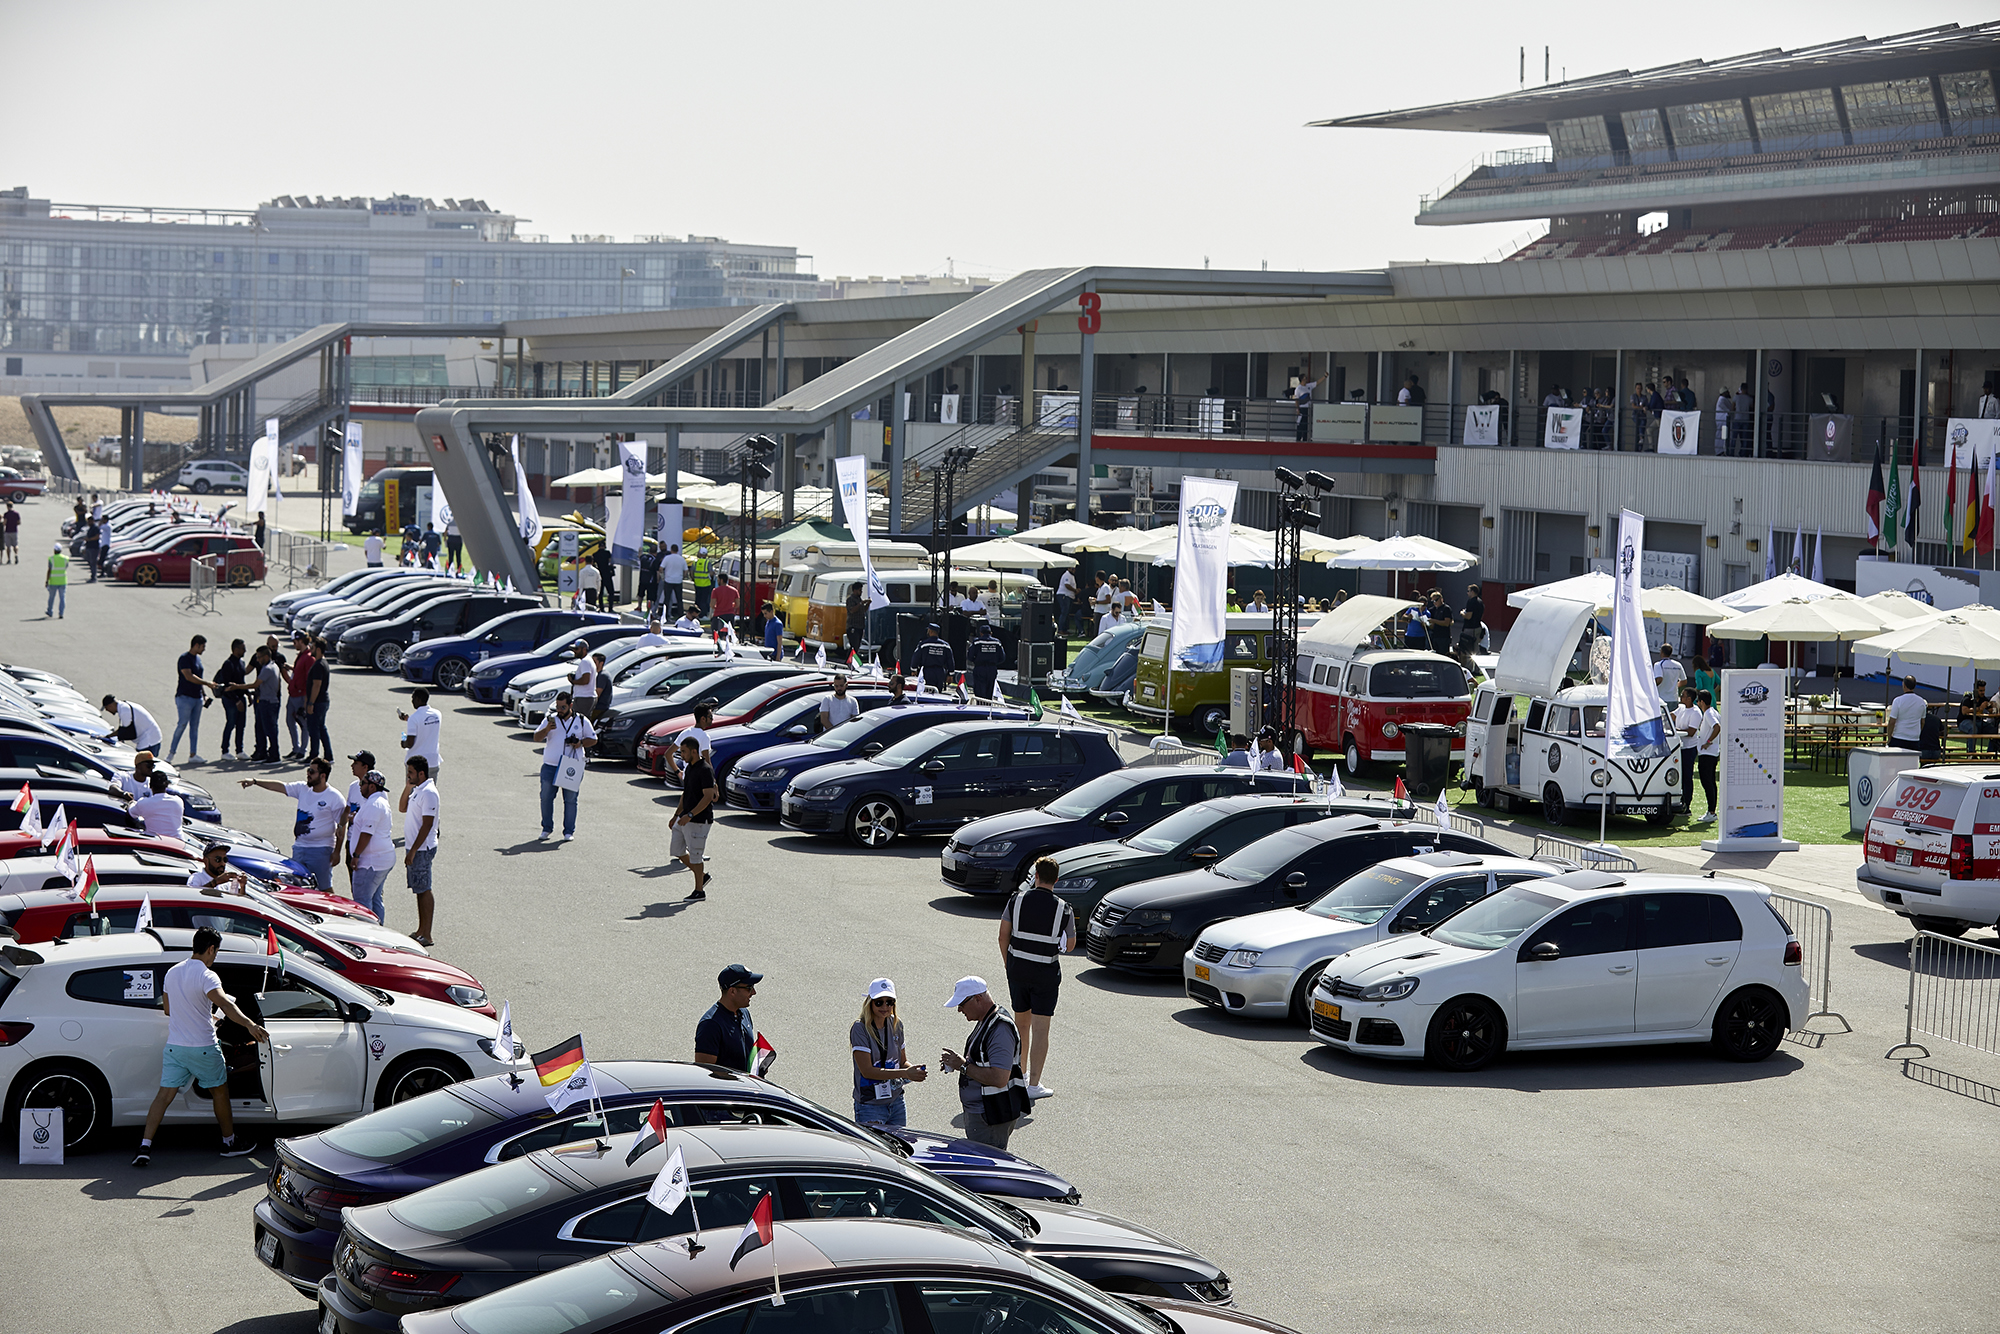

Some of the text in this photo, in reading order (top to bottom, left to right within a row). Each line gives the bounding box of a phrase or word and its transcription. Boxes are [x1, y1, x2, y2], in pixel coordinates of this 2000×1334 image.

[1078, 292, 1102, 335] 3
[1193, 505, 1220, 517] DUB
[1198, 516, 1218, 524] DRIVE
[1744, 686, 1764, 696] DUB
[1896, 786, 1942, 811] 999
[1627, 807, 1658, 816] CLASSIC
[1892, 809, 1929, 824] EMERGENCY
[1868, 844, 1882, 854] RESCUE
[1989, 848, 2000, 856] DU
[1374, 873, 1403, 886] STANCE
